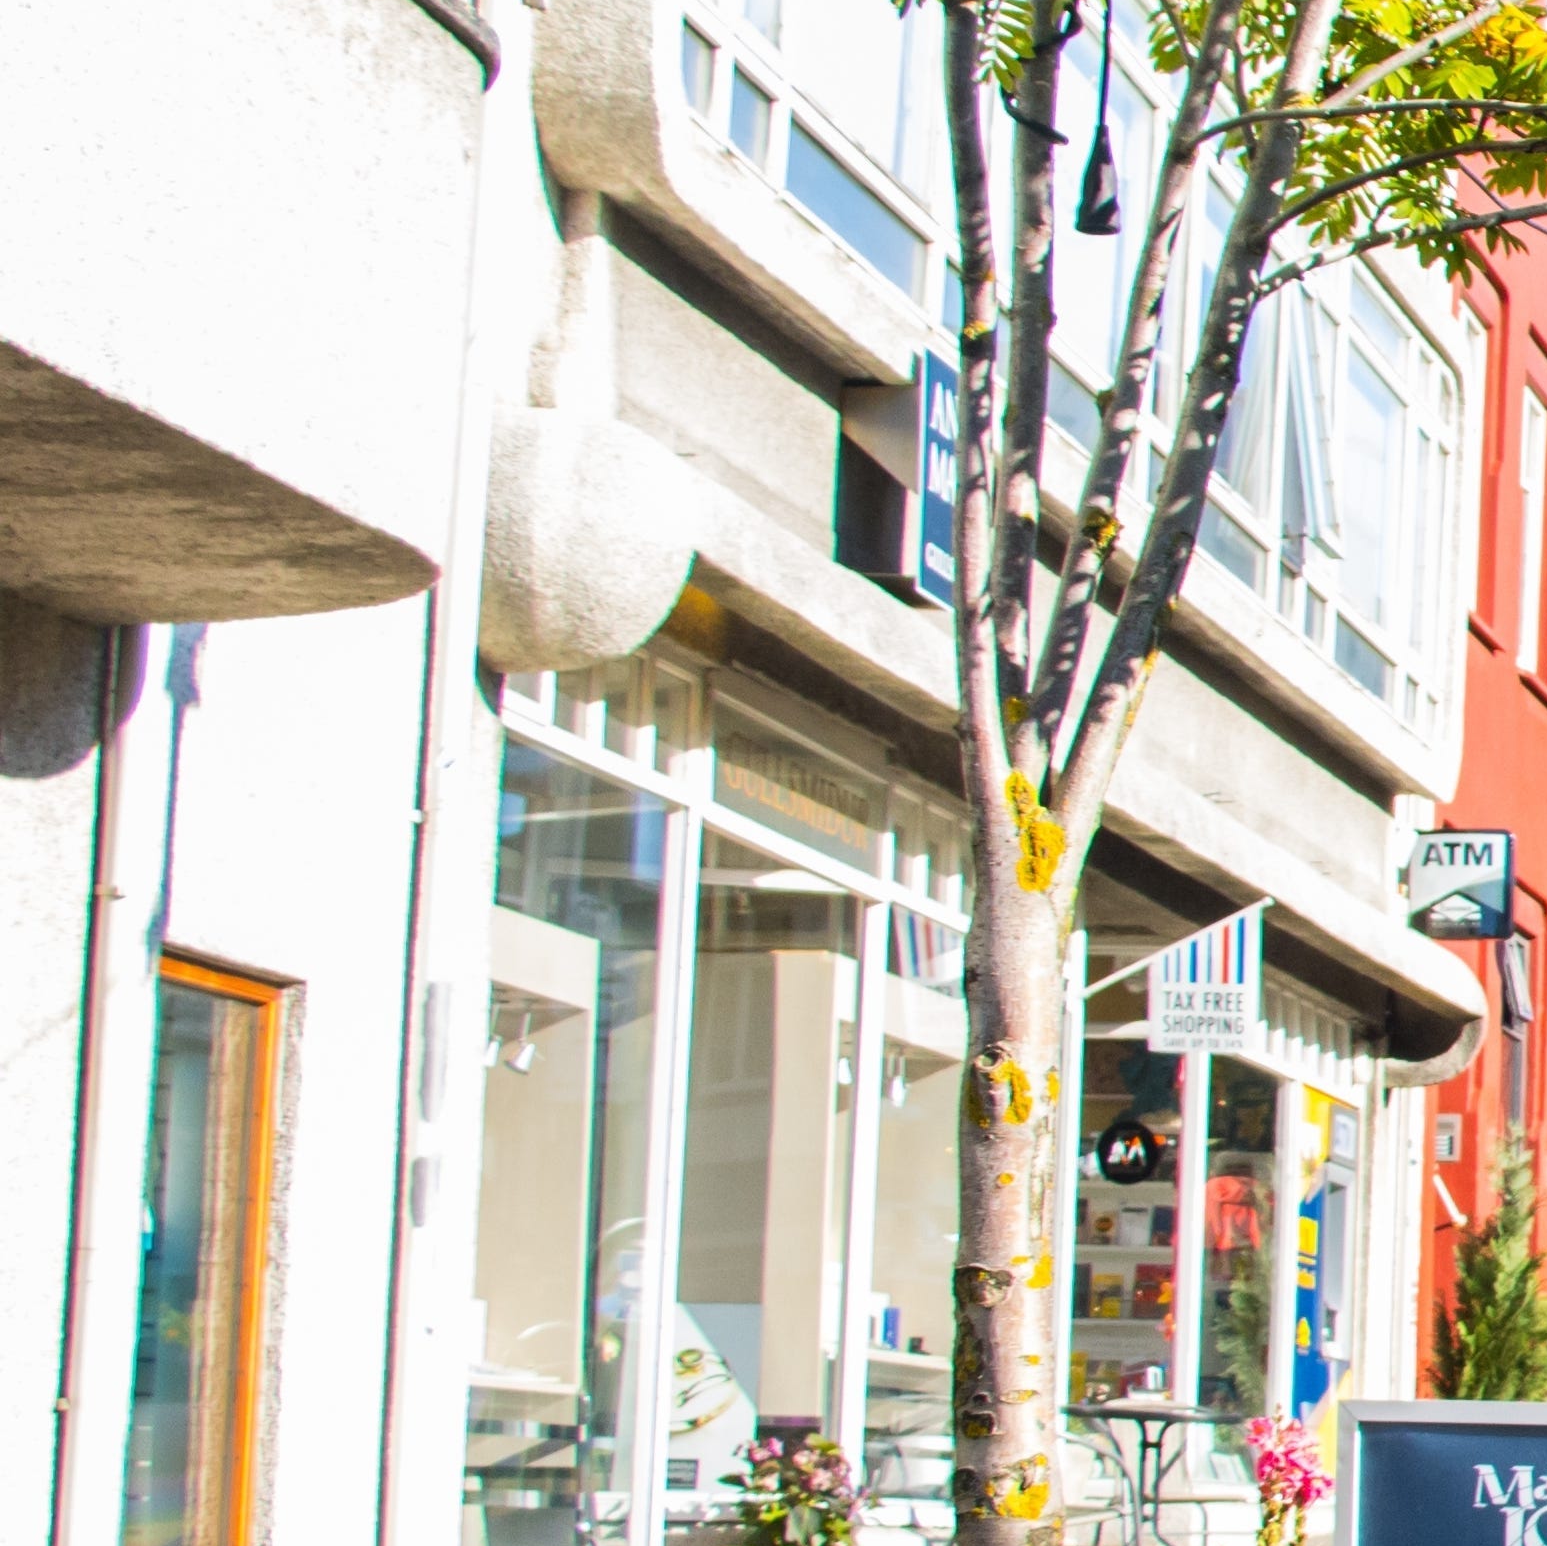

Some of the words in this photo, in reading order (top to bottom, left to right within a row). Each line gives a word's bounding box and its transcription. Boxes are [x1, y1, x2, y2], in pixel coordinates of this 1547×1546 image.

[1421, 842, 1493, 866] ATM
[1163, 990, 1196, 1010] TAX
[1203, 991, 1244, 1012] FREE
[1162, 1015, 1245, 1035] SHOPPING
